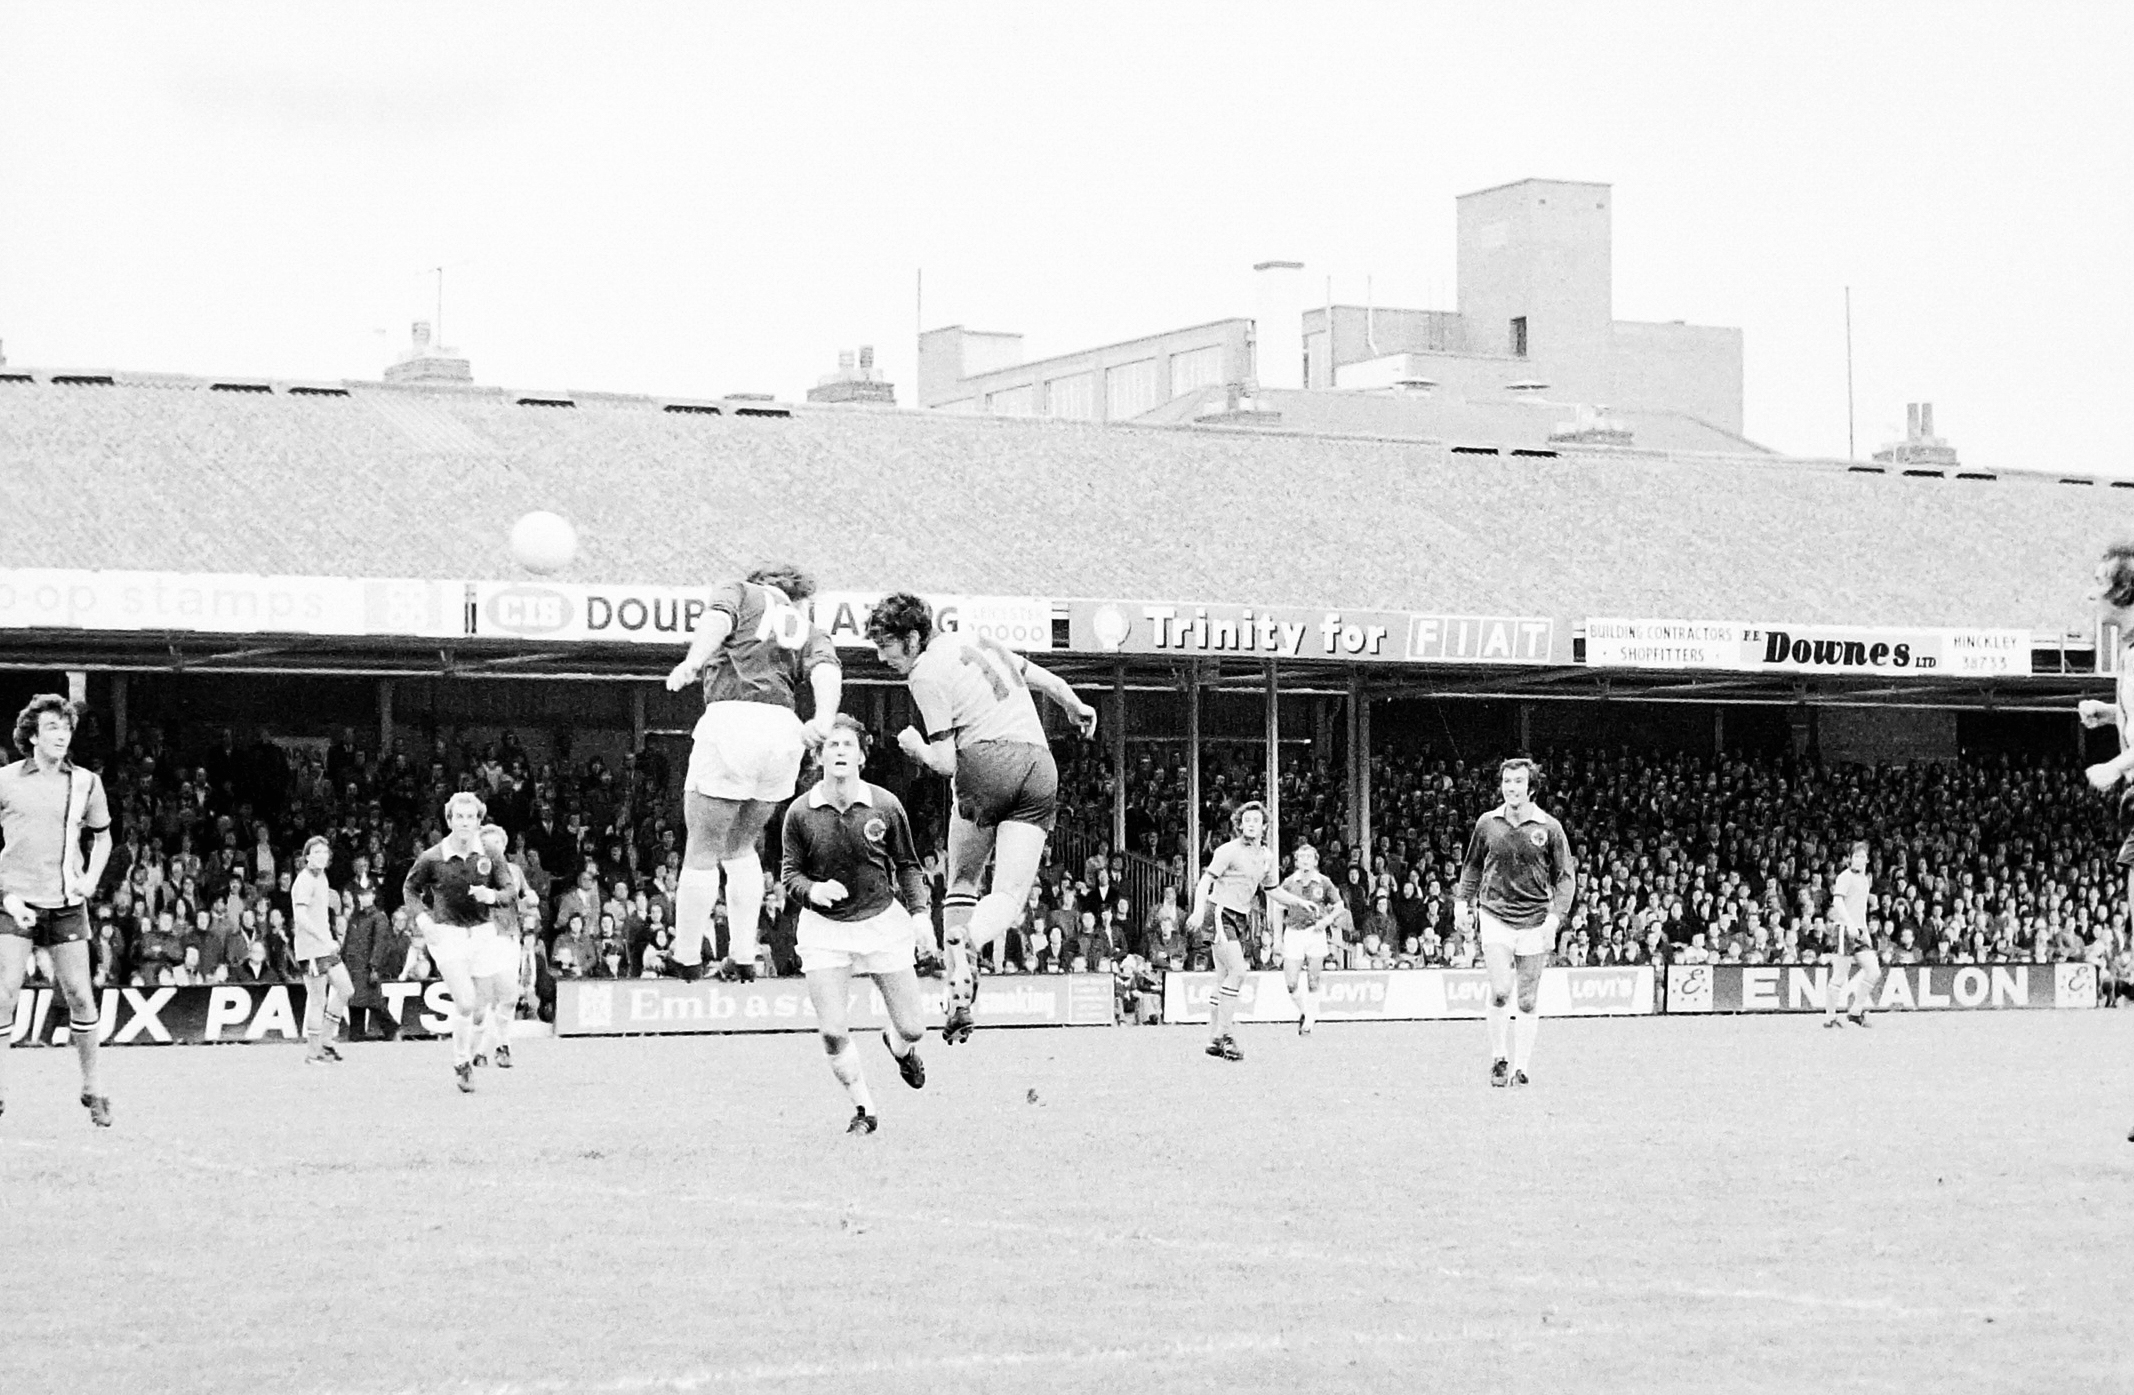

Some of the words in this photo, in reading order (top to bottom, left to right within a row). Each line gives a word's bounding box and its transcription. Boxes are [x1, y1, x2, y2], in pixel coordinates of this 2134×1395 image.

[120, 577, 324, 628] stamps
[586, 596, 708, 634] DOUB
[754, 594, 809, 650] 10
[1143, 606, 1306, 656] Trinity
[1319, 613, 1387, 655] for
[1414, 619, 1548, 658] FIAT
[1589, 624, 1643, 639] BUILDING
[1646, 626, 1732, 642] CONTRACTORS
[1762, 630, 1911, 668] Downes
[1914, 655, 1937, 669] LTD
[1953, 635, 2017, 650] HINCKLEY
[1619, 646, 1705, 662] SHOPFITTERS
[204, 982, 456, 1042] PATS
